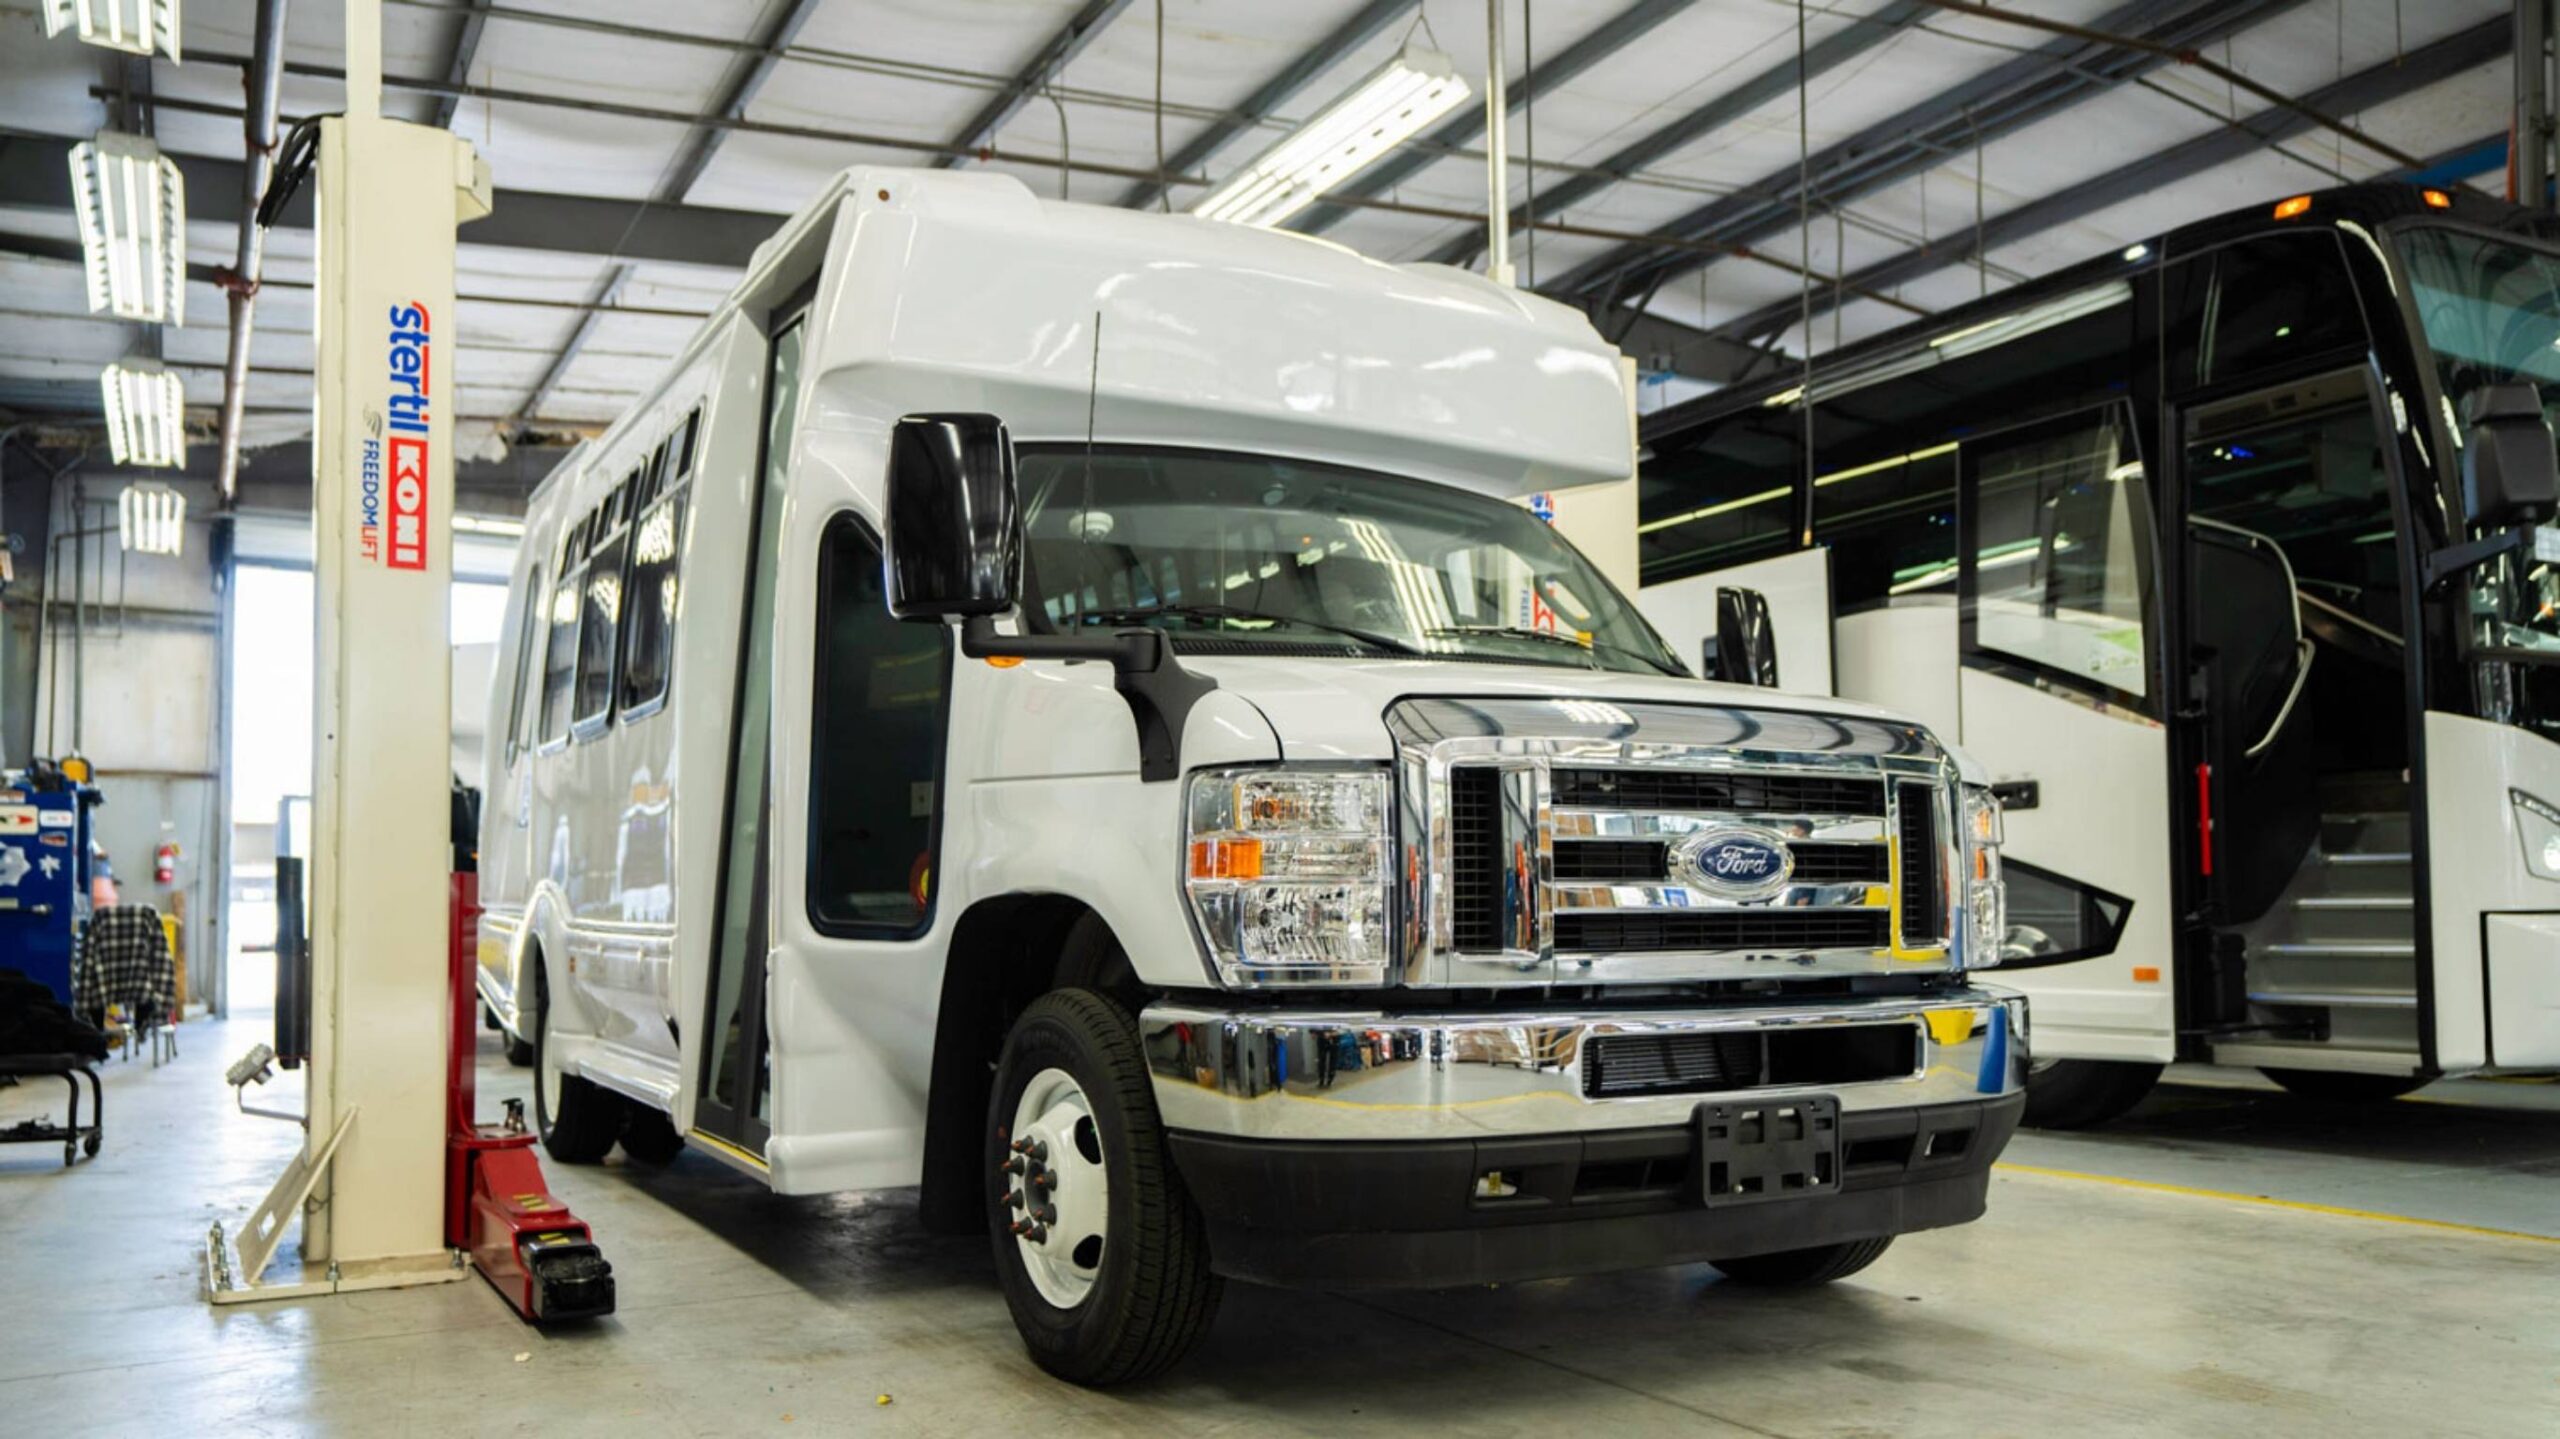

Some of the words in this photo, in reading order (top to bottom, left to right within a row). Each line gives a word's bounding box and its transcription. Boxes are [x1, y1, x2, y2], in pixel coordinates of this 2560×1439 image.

[388, 302, 430, 433] stertil
[361, 440, 380, 562] FREEDOMLIFT
[395, 445, 422, 564] KONI
[1714, 845, 1769, 874] Ford
